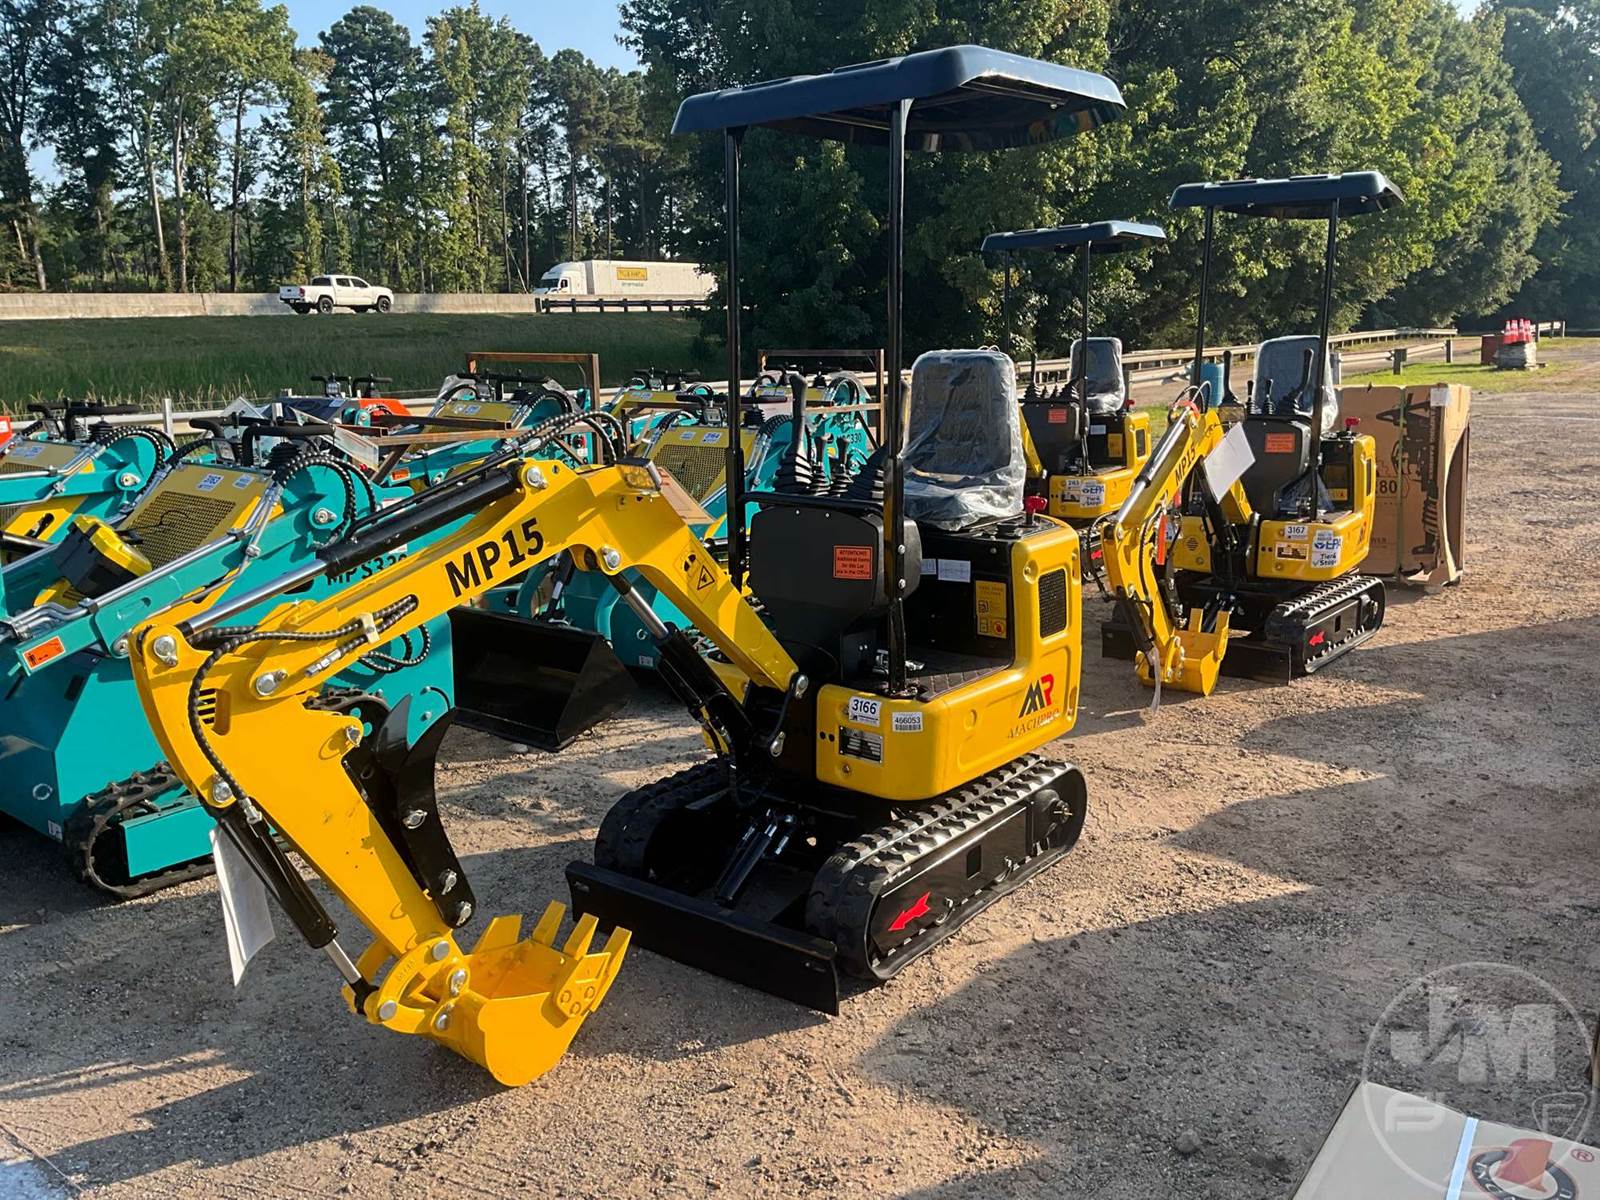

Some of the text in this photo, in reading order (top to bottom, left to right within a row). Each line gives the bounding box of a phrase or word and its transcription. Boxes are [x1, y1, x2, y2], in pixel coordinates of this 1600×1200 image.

[1175, 441, 1195, 487] MP15
[1287, 526, 1306, 534] 3167
[445, 517, 544, 598] MP15
[852, 699, 877, 714] 3166
[895, 716, 921, 724] 466053
